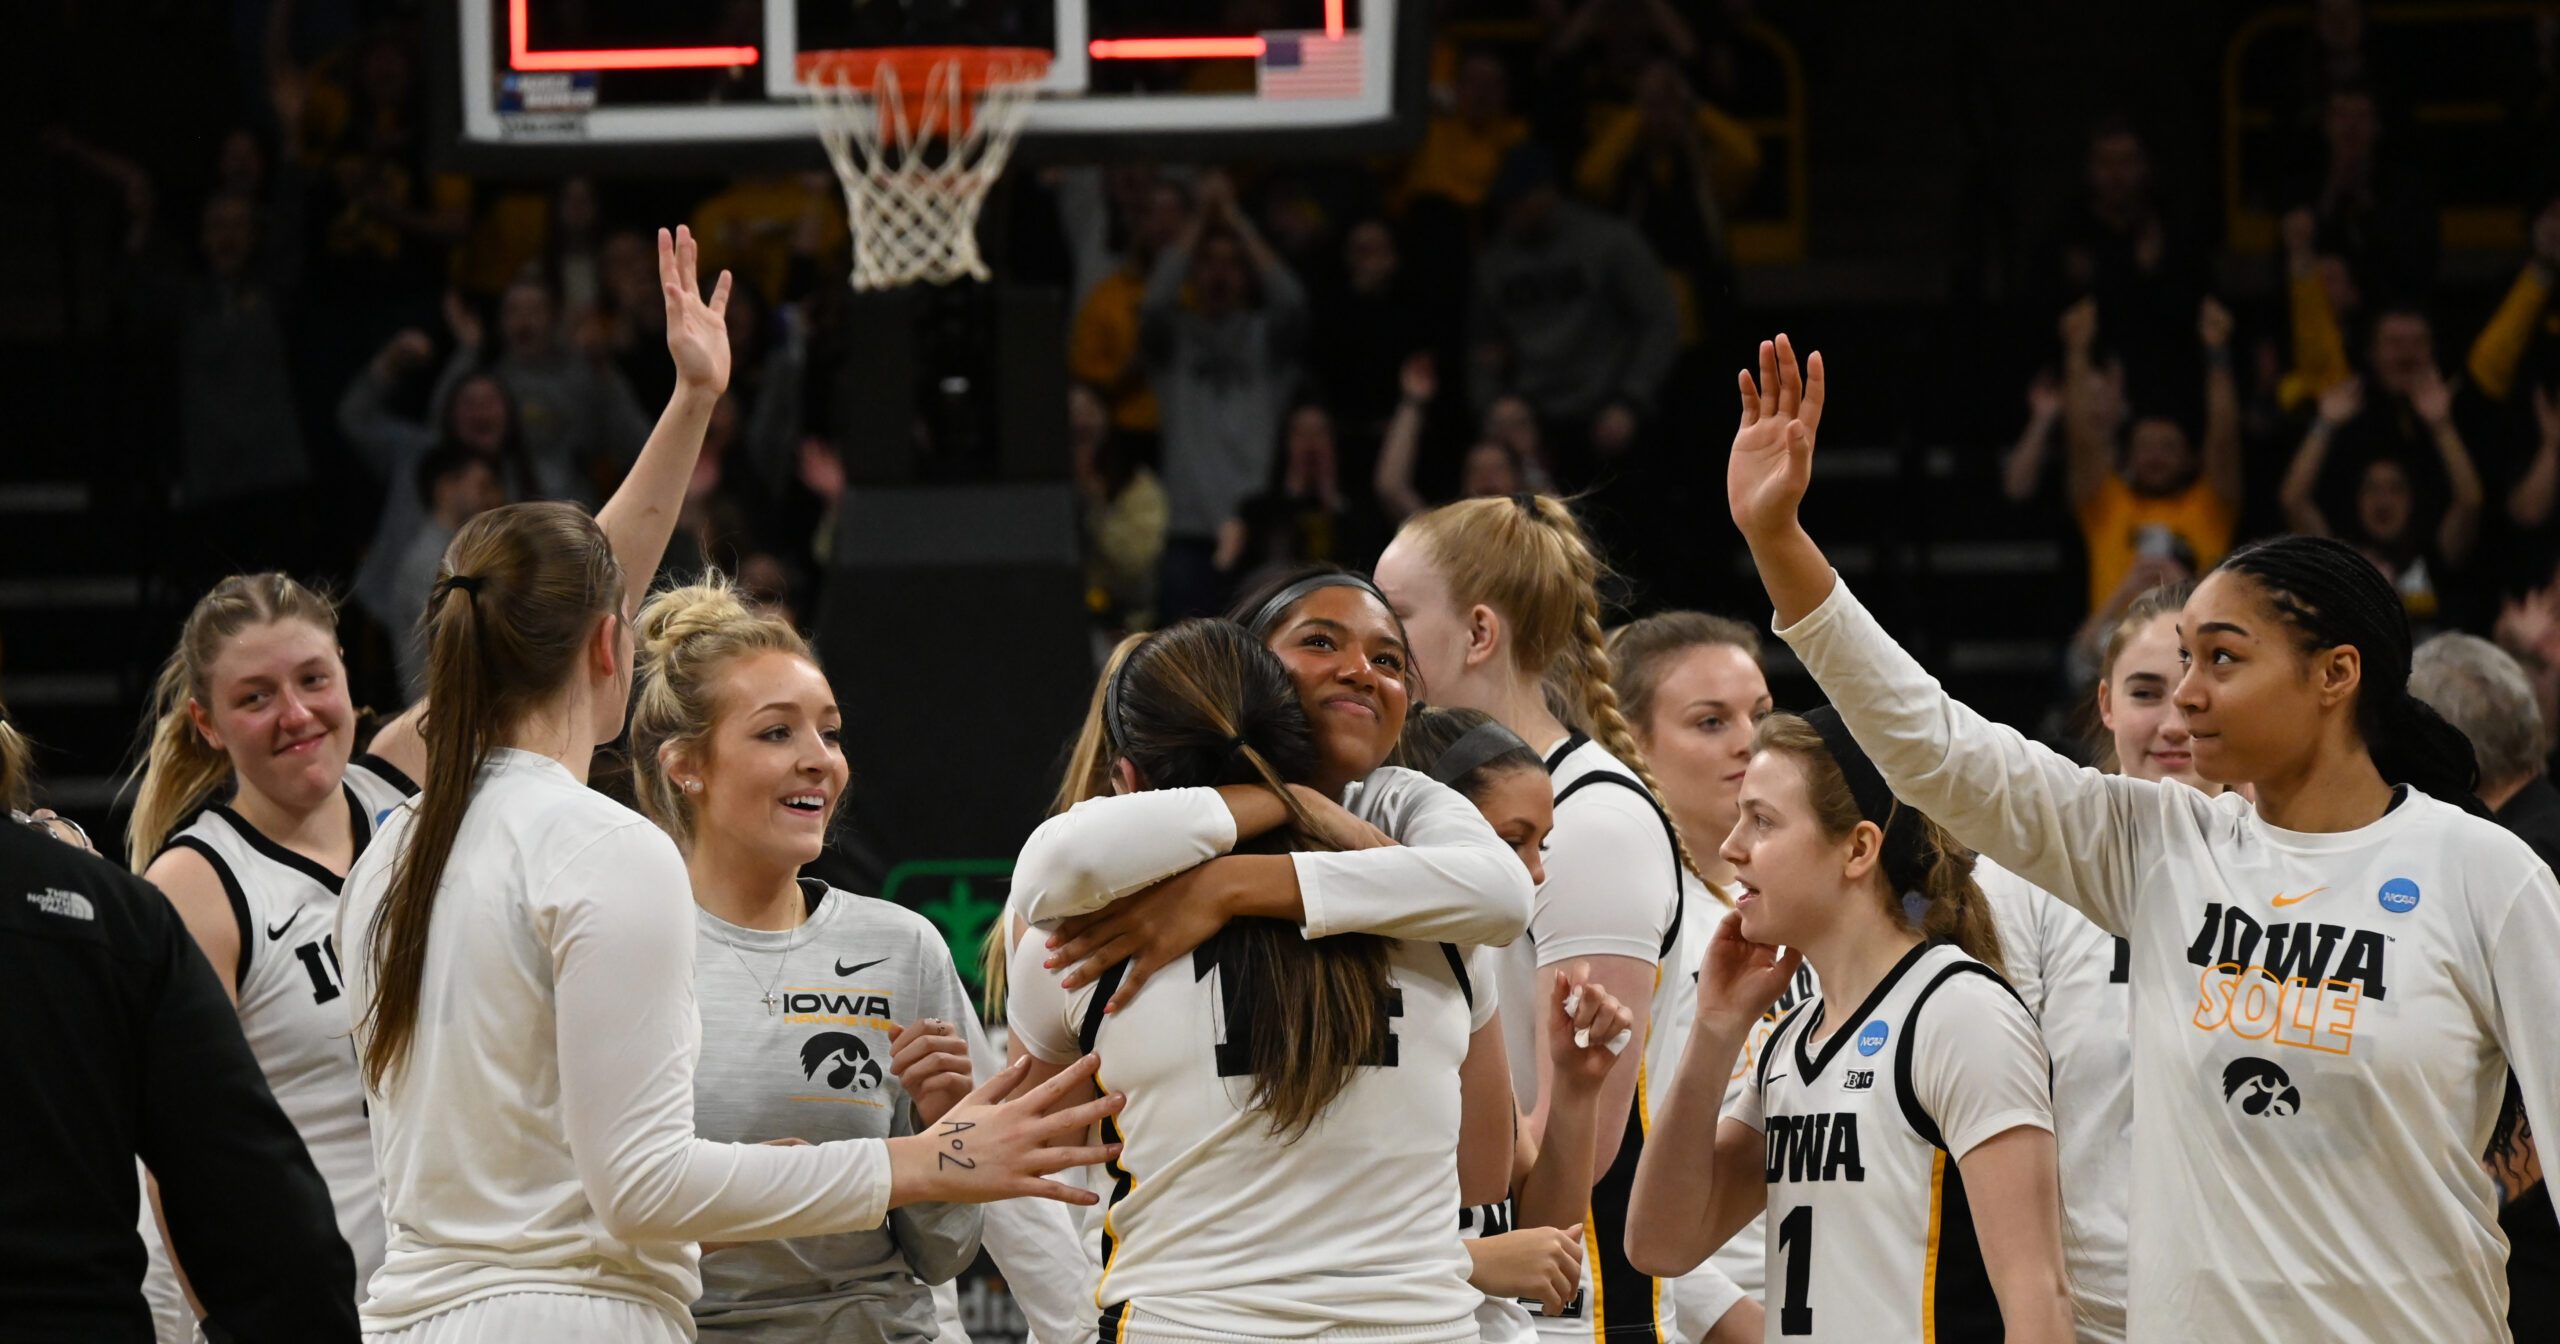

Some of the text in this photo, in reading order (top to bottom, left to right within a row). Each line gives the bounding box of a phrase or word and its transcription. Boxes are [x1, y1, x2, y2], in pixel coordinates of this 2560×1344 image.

[2383, 891, 2416, 905] NCAA
[2187, 903, 2386, 1001] IOWA
[783, 993, 891, 1019] IOWA
[2193, 962, 2362, 1055] SOLE
[1765, 1112, 1866, 1184] OWA
[1779, 1205, 1813, 1335] 1
